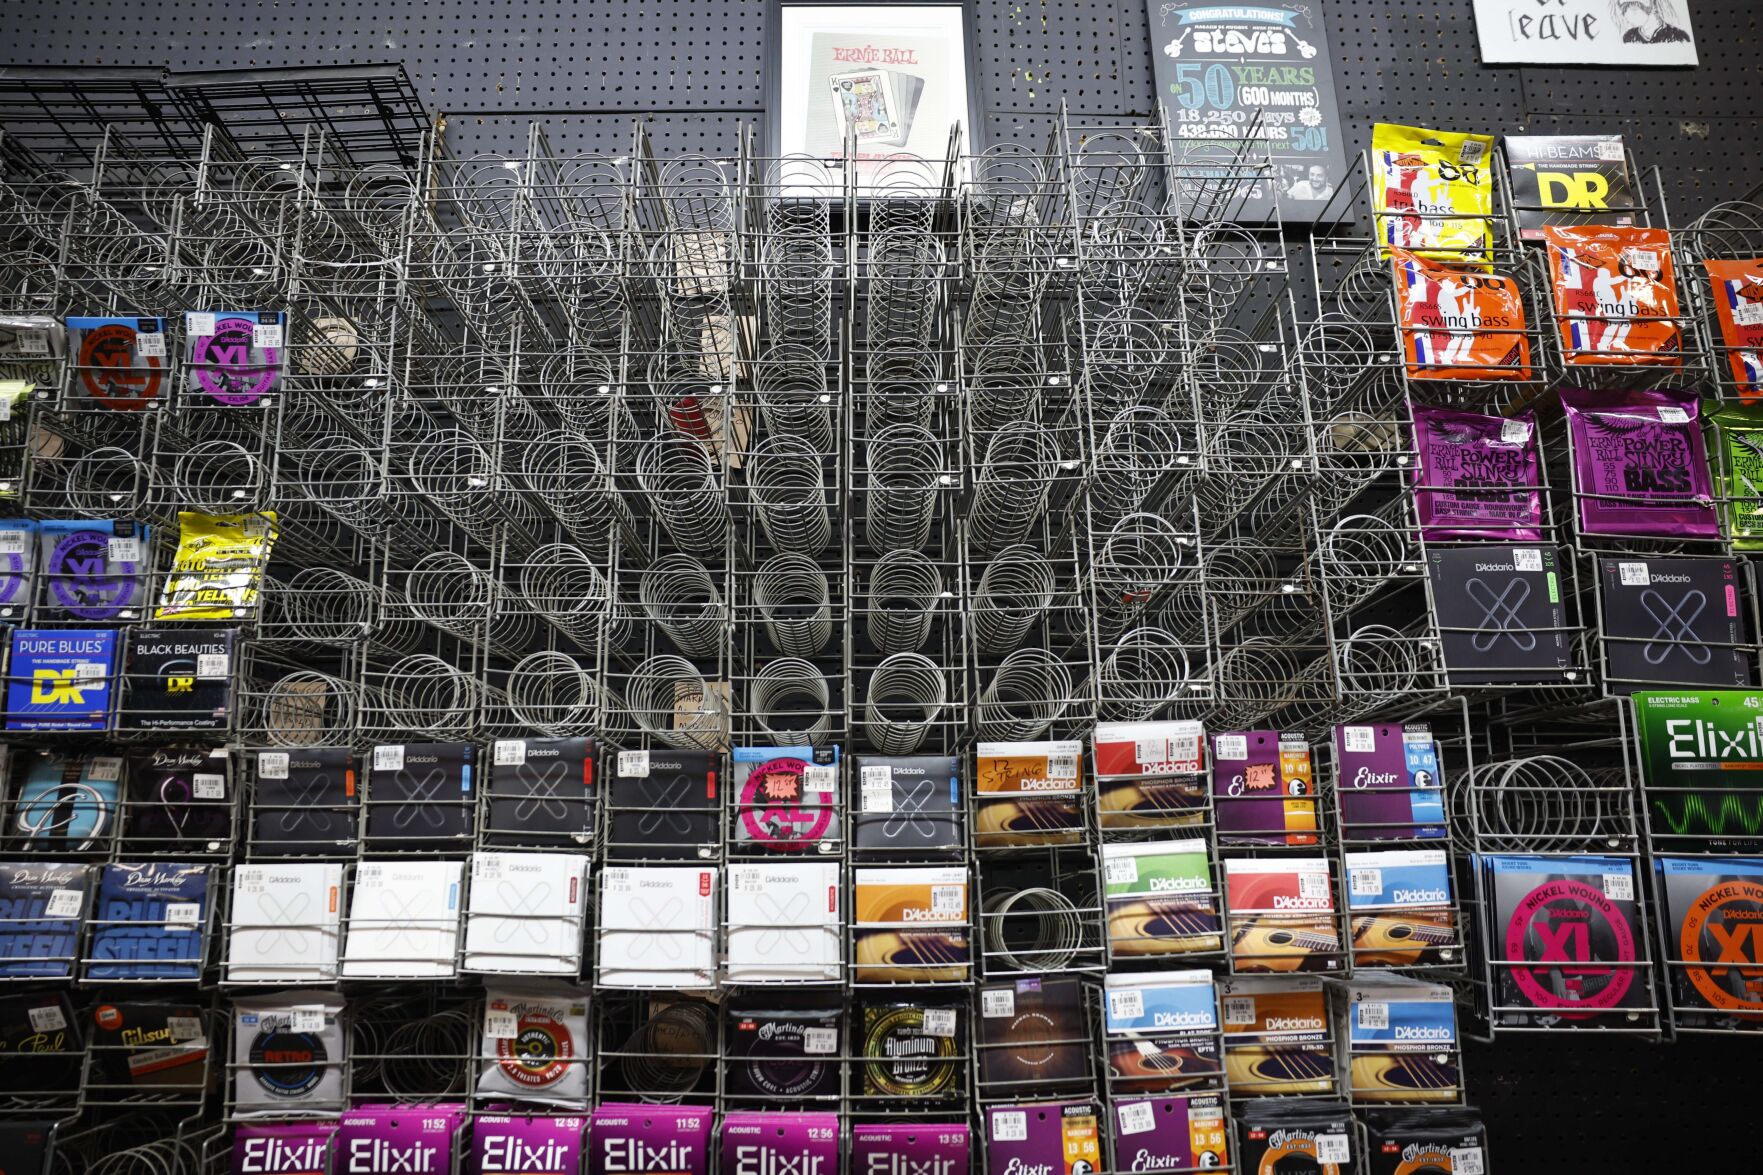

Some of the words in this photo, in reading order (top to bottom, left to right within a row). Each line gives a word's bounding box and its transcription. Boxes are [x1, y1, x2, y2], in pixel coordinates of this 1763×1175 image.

[1189, 7, 1284, 21] CONGRATULATIONS!
[1509, 9, 1600, 42] leave
[880, 48, 918, 64] BALL
[1170, 83, 1182, 94] ON
[1176, 63, 1235, 110] 50
[1232, 66, 1315, 85] YEARS
[1237, 86, 1269, 106] (600
[1271, 87, 1320, 107] MONTHS)
[1177, 109, 1246, 125] 18,250
[1242, 126, 1288, 139] HOURS
[1290, 126, 1329, 151] 50!
[1527, 146, 1600, 159] HI-BEAMS
[1536, 172, 1609, 212] DR
[1393, 200, 1415, 211] tru
[1419, 200, 1455, 214] bass
[1577, 299, 1625, 317] swing
[1629, 301, 1667, 317] bass
[1421, 312, 1468, 328] swing
[1471, 312, 1510, 327] bass
[96, 352, 146, 384] XL
[211, 345, 261, 378] XL
[1623, 437, 1685, 451] POWER
[1461, 449, 1521, 465] POWER
[1596, 449, 1623, 462] BALL
[1624, 451, 1686, 470] SLINKY
[1435, 457, 1458, 471] BALL
[1461, 462, 1520, 482] SLINKY
[1738, 469, 1762, 483] BALL
[1624, 469, 1692, 492] BASS
[67, 558, 118, 591] XL
[1475, 563, 1514, 572] D'Addario
[1651, 573, 1691, 583] D'Addario
[20, 641, 56, 653] PURE
[59, 641, 102, 653] BLUES
[137, 645, 172, 654] BLACK
[175, 644, 225, 654] BEAUTIES
[168, 677, 193, 691] DR
[1735, 672, 1744, 686] XT
[31, 669, 85, 704] DR
[1744, 697, 1759, 707] 45
[1666, 720, 1763, 757] Elixi
[406, 755, 438, 763] D'Addario
[527, 749, 559, 757] D'Addario
[1410, 755, 1418, 764] 10
[1424, 755, 1432, 764] 47
[290, 760, 321, 769] D'Addario
[649, 761, 682, 770] D'Addario
[894, 767, 925, 775] D'Addario
[993, 760, 1012, 772] 12
[1143, 761, 1198, 774] D'Addario
[1286, 765, 1293, 773] 10
[1298, 765, 1307, 773] 47
[983, 763, 1042, 783] STRING
[1249, 771, 1259, 782] 12
[1354, 767, 1398, 789] Elixir
[773, 780, 783, 792] 12
[1021, 778, 1076, 790] D'Addario
[509, 864, 541, 872] D'Addario
[269, 875, 301, 884] D'Addario
[640, 880, 673, 888] D'Addario
[765, 875, 799, 884] D'Addario
[1149, 876, 1207, 890] D'Addario
[1273, 896, 1329, 908] D'Addario
[1393, 888, 1446, 902] D'Addario
[1526, 886, 1565, 910] NICKEL
[1568, 886, 1611, 912] WOUND
[1699, 887, 1739, 910] NICKEL
[903, 908, 962, 921] D'Addario
[1549, 909, 1589, 918] D'Addario
[1532, 922, 1612, 974] XL
[1225, 985, 1231, 994] 3
[1357, 992, 1362, 1001] 3
[1154, 1011, 1211, 1026] D'Addario
[1266, 1017, 1322, 1030] D'Addario
[1395, 1026, 1450, 1039] D'Addario
[885, 1036, 935, 1055] Aluminum
[893, 1056, 928, 1074] Bronze
[344, 1118, 376, 1126] ACOUSTIC
[434, 1119, 445, 1129] 52
[479, 1115, 510, 1123] ACOUSTIC
[554, 1117, 566, 1127] 12
[567, 1118, 579, 1128] 53
[595, 1118, 628, 1126] ACOUSTIC
[688, 1118, 700, 1128] 52
[728, 1126, 761, 1134] ACOUSTIC
[807, 1128, 819, 1139] 12
[820, 1128, 833, 1139] 56
[859, 1134, 892, 1142] ACOUSTIC
[939, 1134, 950, 1144] 13
[952, 1134, 964, 1144] 53
[1195, 1134, 1205, 1145] 13
[1210, 1133, 1221, 1144] 56
[243, 1138, 325, 1170] Elixir
[482, 1136, 568, 1170] Elixir
[604, 1138, 692, 1171] Elixir
[1068, 1143, 1078, 1154] 13
[1083, 1142, 1095, 1153] 56
[350, 1139, 435, 1172] Elixir
[736, 1146, 824, 1175] Elixir
[1132, 1149, 1180, 1172] Elixir
[867, 1153, 955, 1175] Elixir
[1004, 1157, 1053, 1175] Elixir
